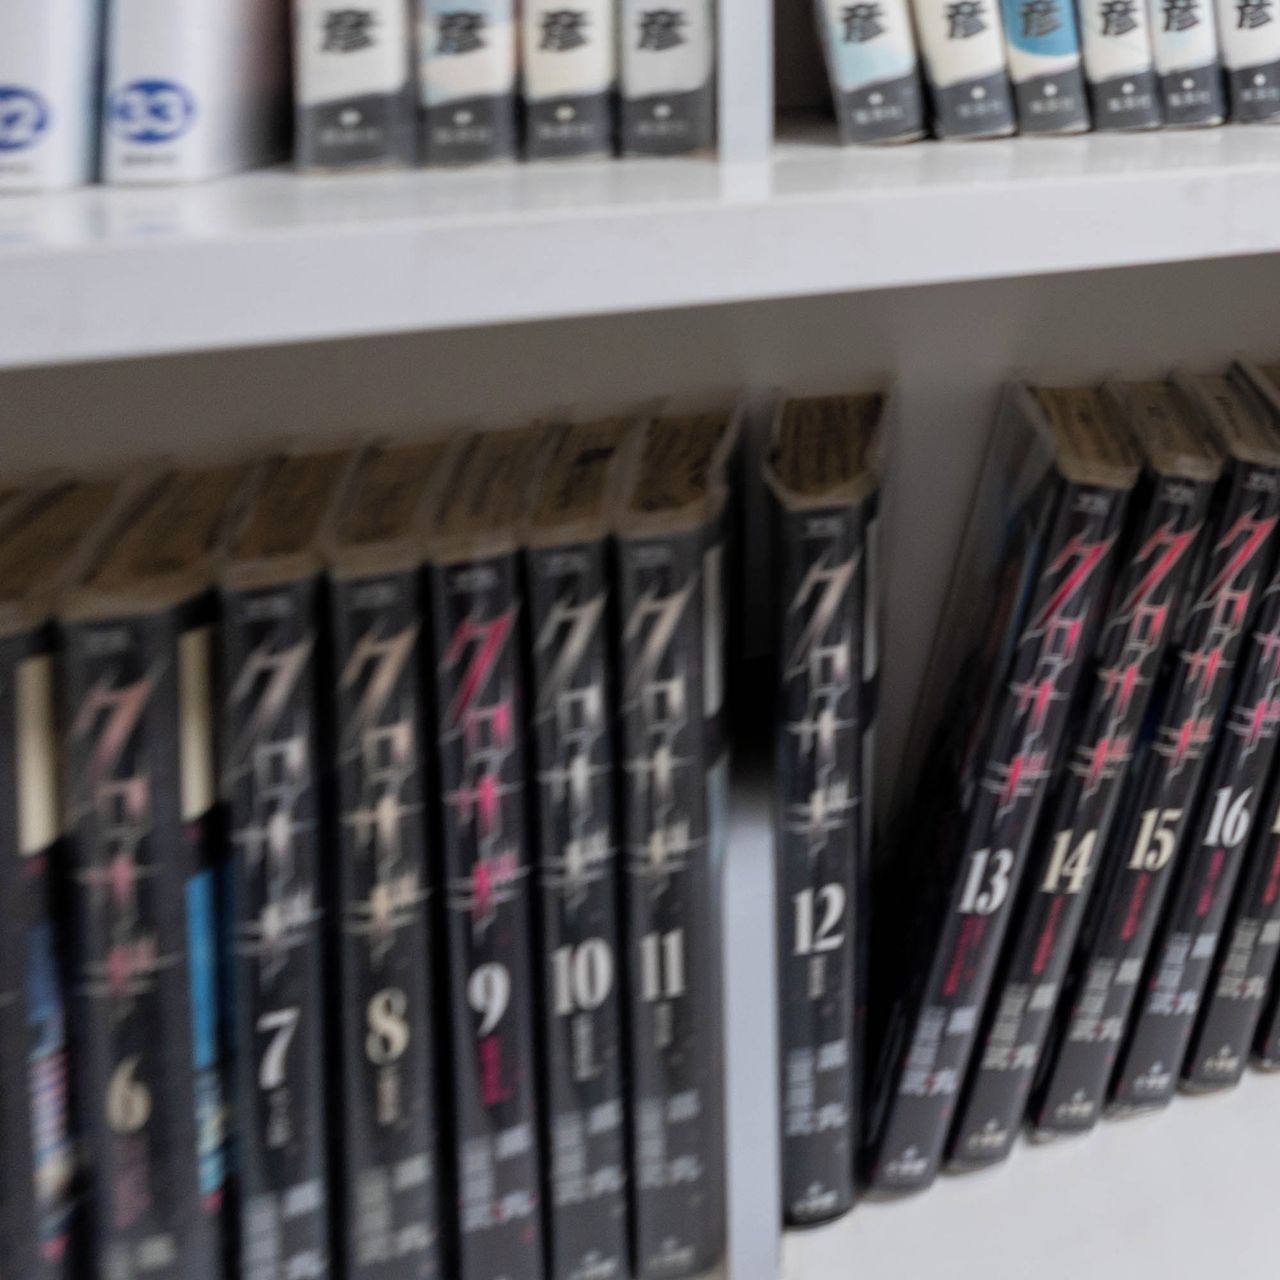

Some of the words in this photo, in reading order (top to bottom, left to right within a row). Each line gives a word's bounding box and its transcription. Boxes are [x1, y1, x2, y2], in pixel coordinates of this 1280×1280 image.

[1129, 808, 1183, 873] 15
[1203, 787, 1253, 849] 16
[961, 848, 1015, 917] 13
[1042, 829, 1096, 895] 14
[794, 883, 847, 957] 12
[469, 963, 511, 1035] 9
[552, 937, 614, 1012] 10
[640, 928, 686, 1000] 11
[257, 1007, 302, 1090] 7
[365, 988, 410, 1066] 8
[107, 1057, 153, 1135] 6
